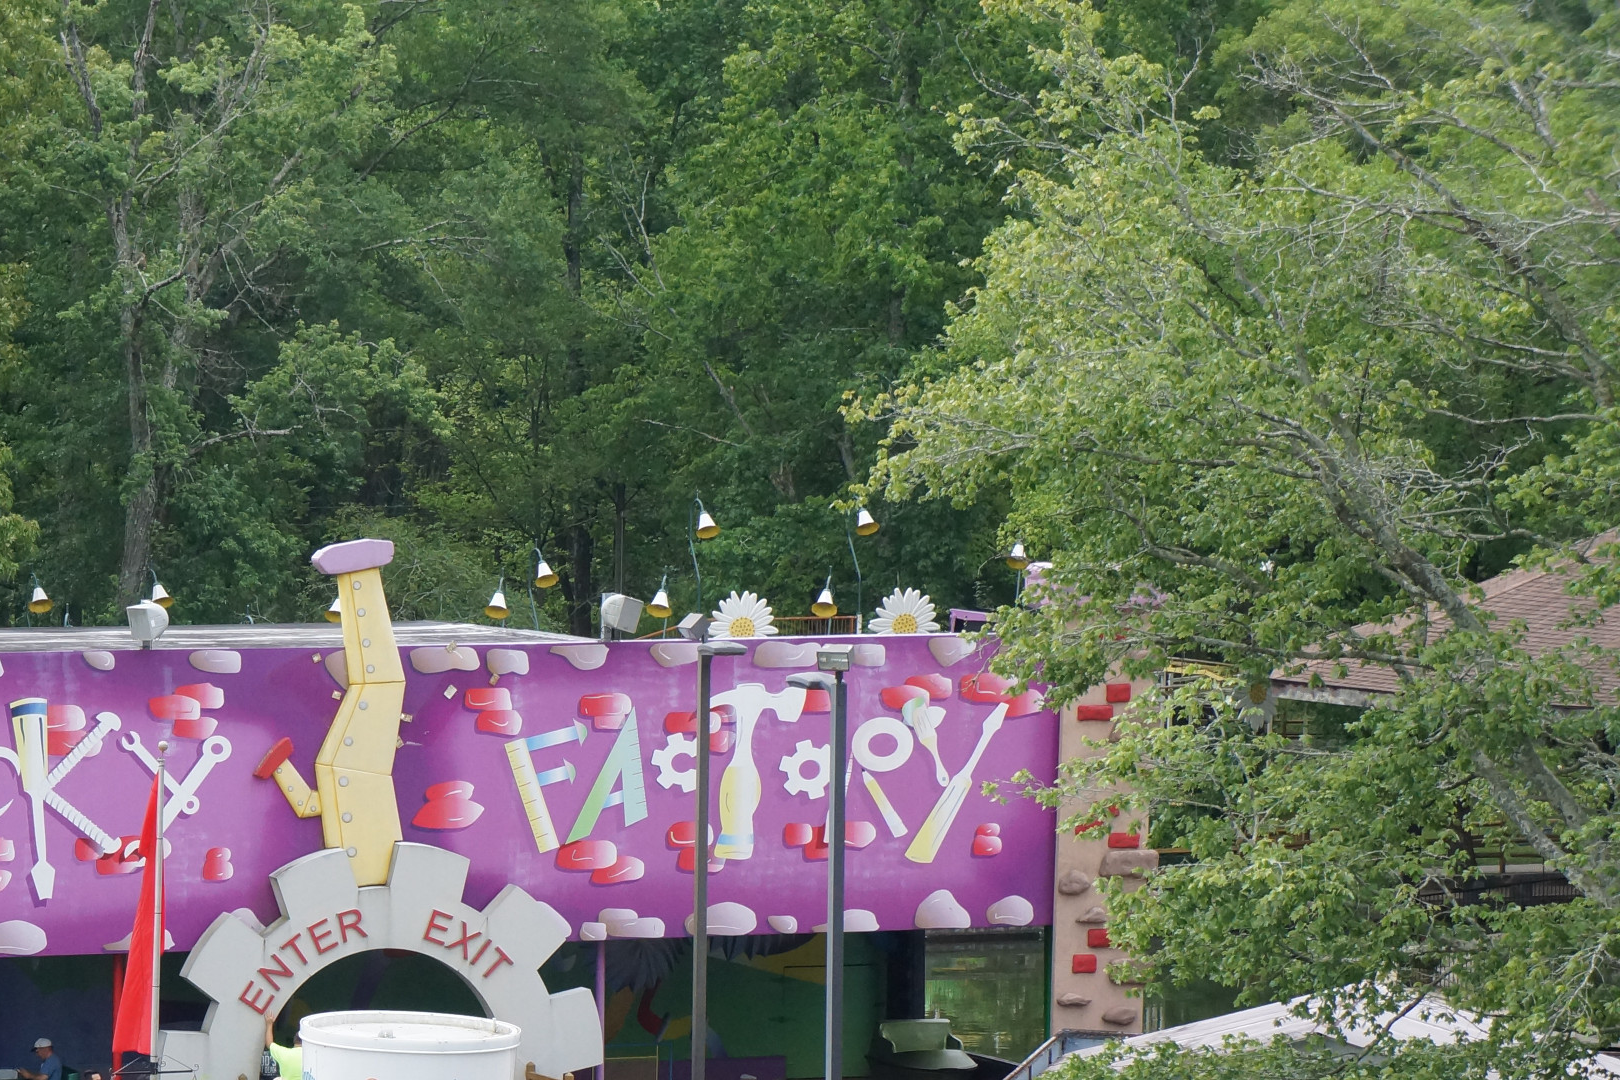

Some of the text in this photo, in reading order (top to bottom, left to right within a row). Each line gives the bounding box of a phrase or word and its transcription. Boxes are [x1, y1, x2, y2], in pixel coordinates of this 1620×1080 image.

[504, 682, 1010, 863] FACTORY
[238, 908, 368, 1016] ENTER
[423, 908, 514, 979] EXIT
